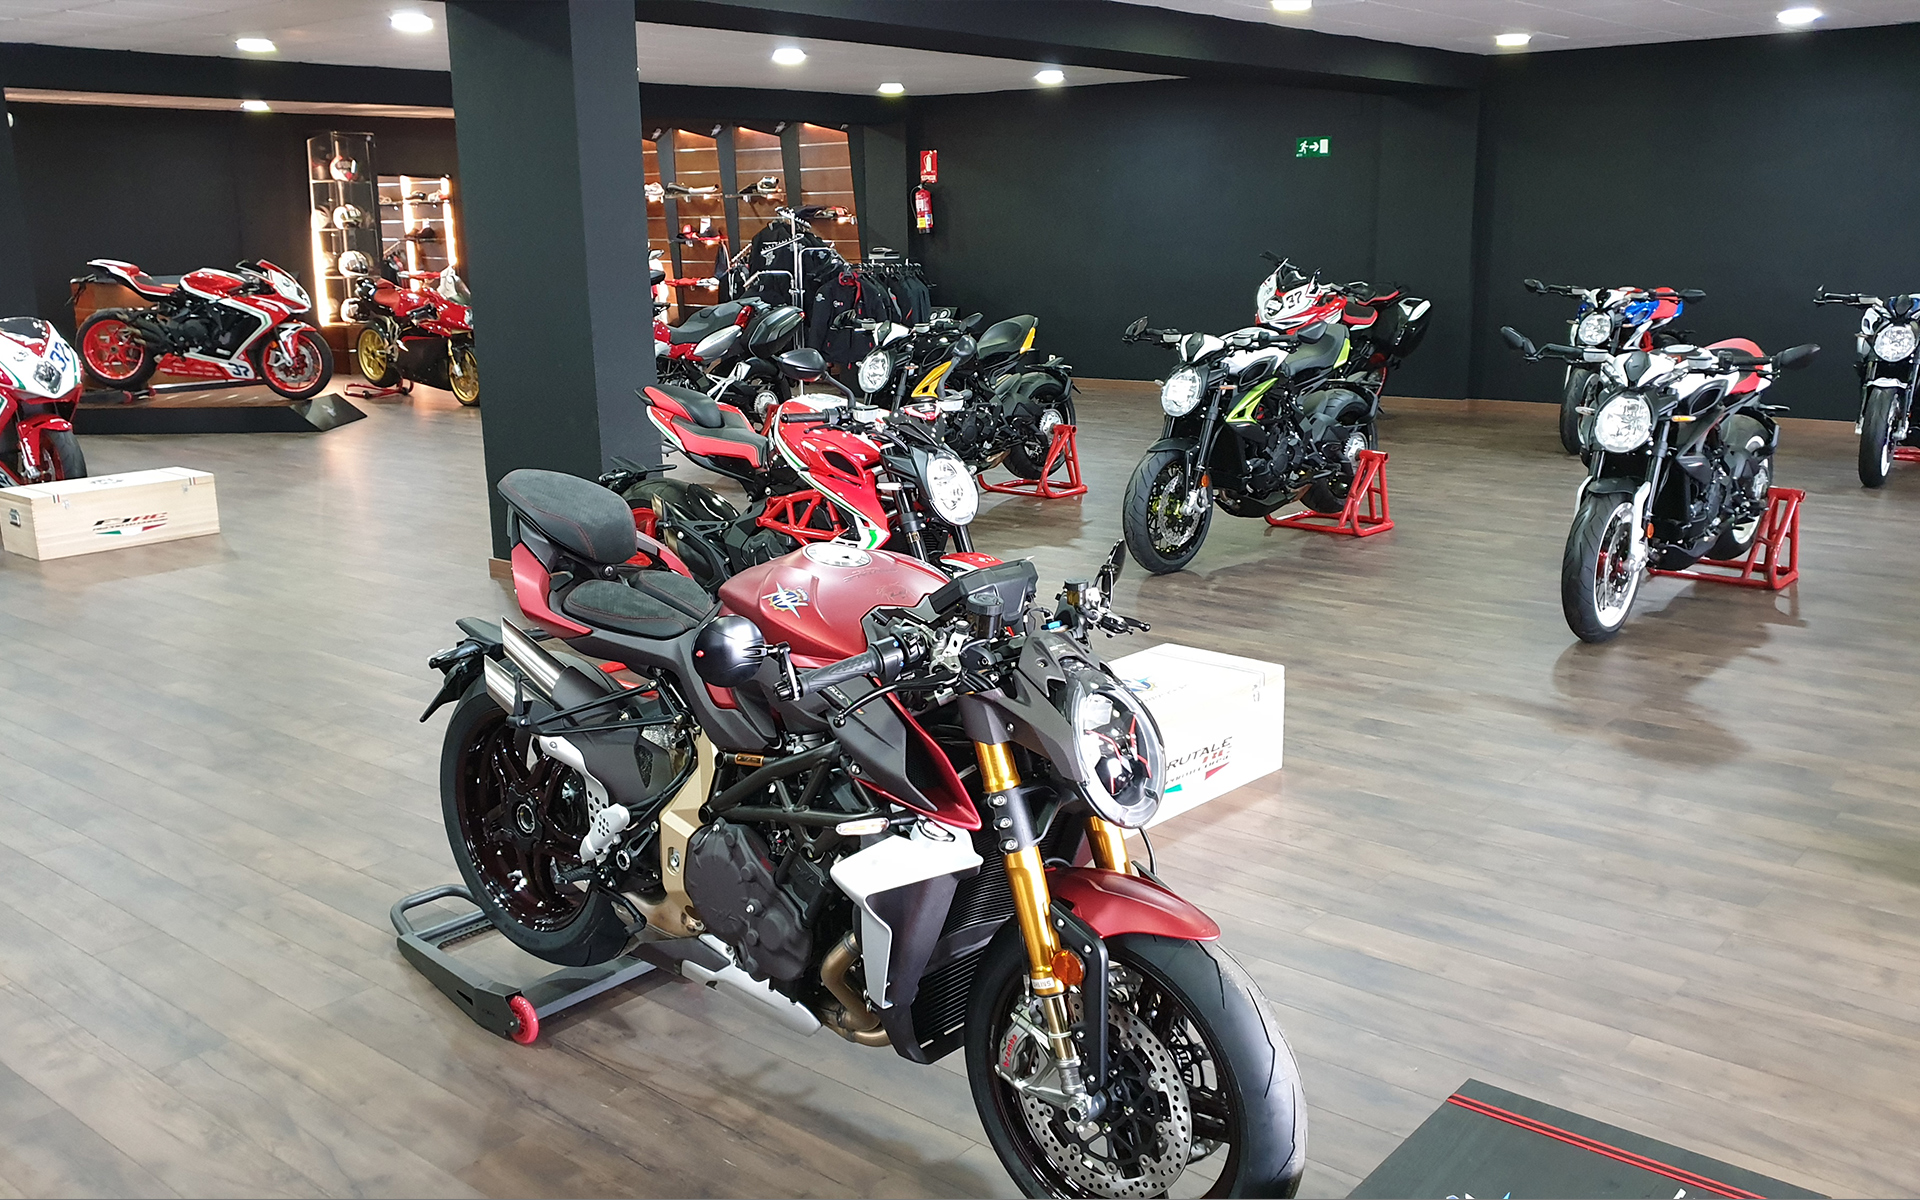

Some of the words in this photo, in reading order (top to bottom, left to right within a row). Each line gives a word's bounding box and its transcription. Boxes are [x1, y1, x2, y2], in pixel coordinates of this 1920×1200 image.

[227, 362, 250, 378] 37
[1166, 736, 1233, 772] RUTALE
[1002, 1034, 1018, 1067] brembo
